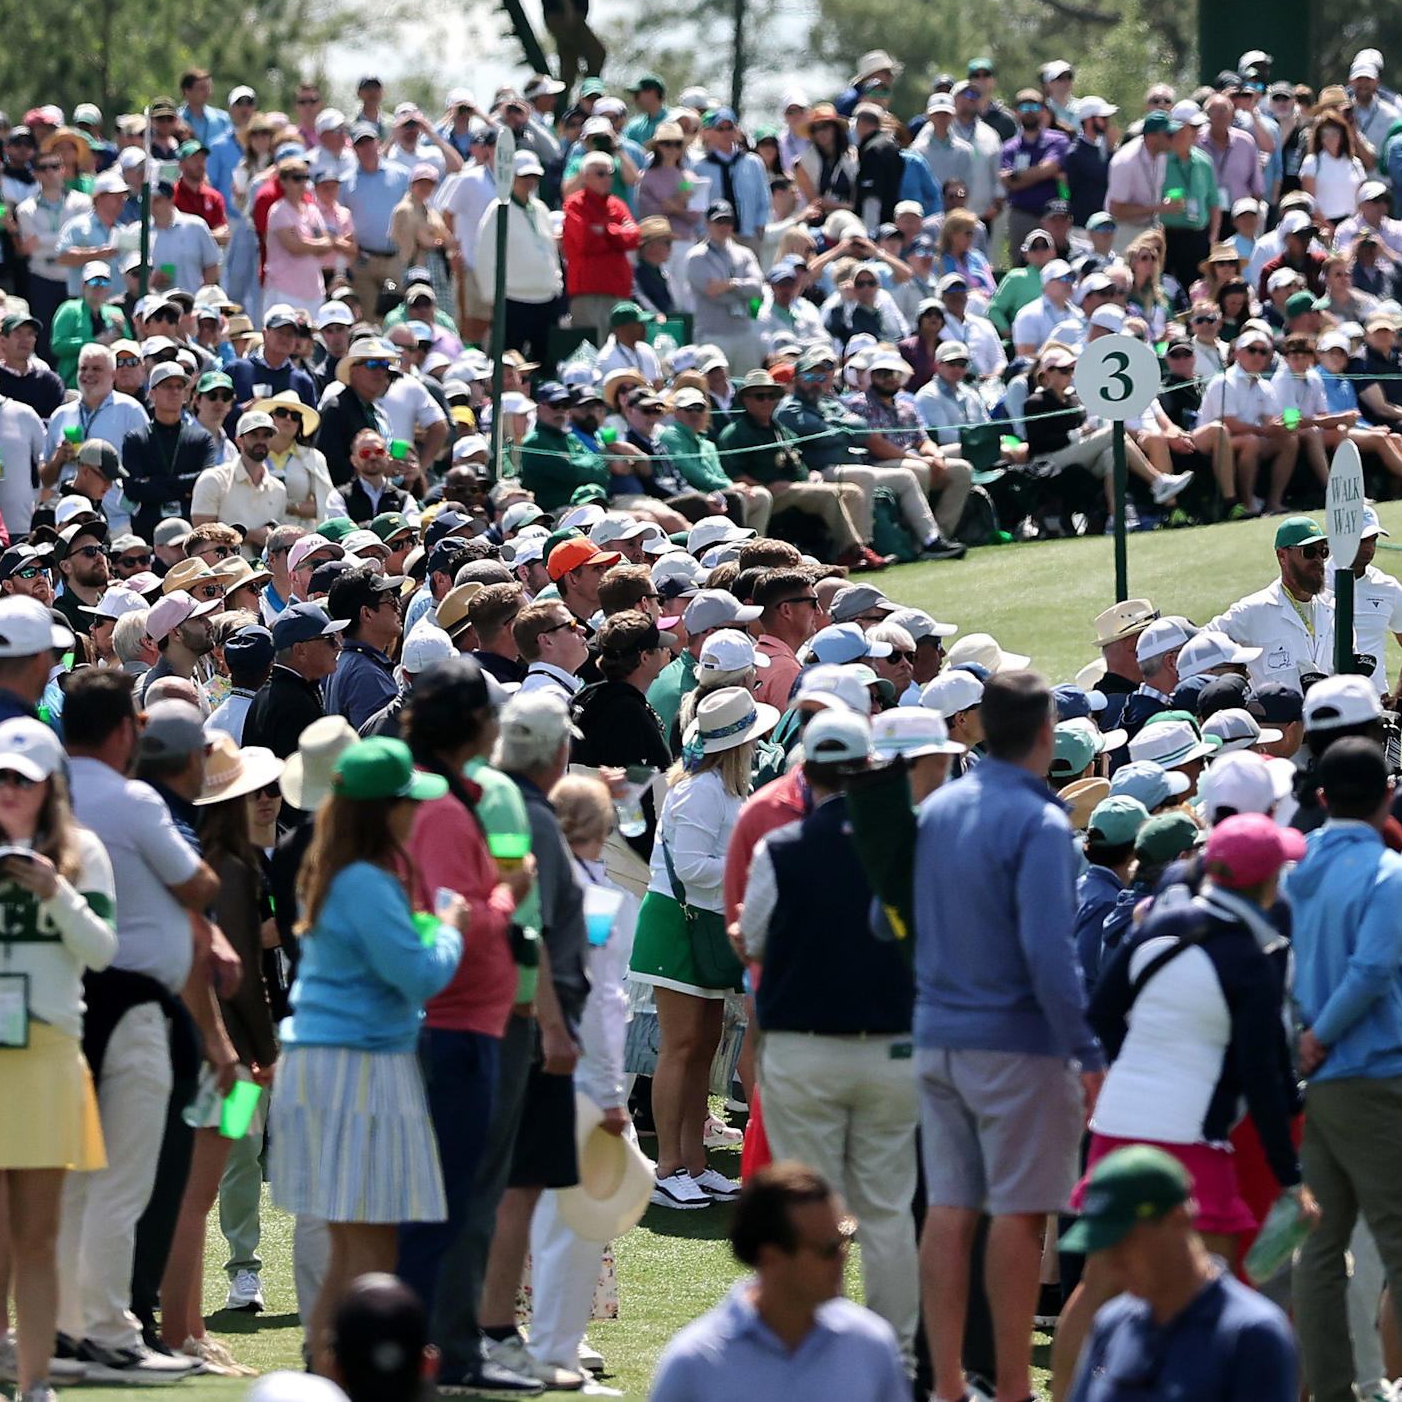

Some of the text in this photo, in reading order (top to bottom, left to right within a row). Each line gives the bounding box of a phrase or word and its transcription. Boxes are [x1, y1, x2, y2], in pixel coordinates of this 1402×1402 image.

[1100, 352, 1133, 401] 3
[1331, 476, 1360, 504] WALK
[1333, 507, 1357, 536] WAY
